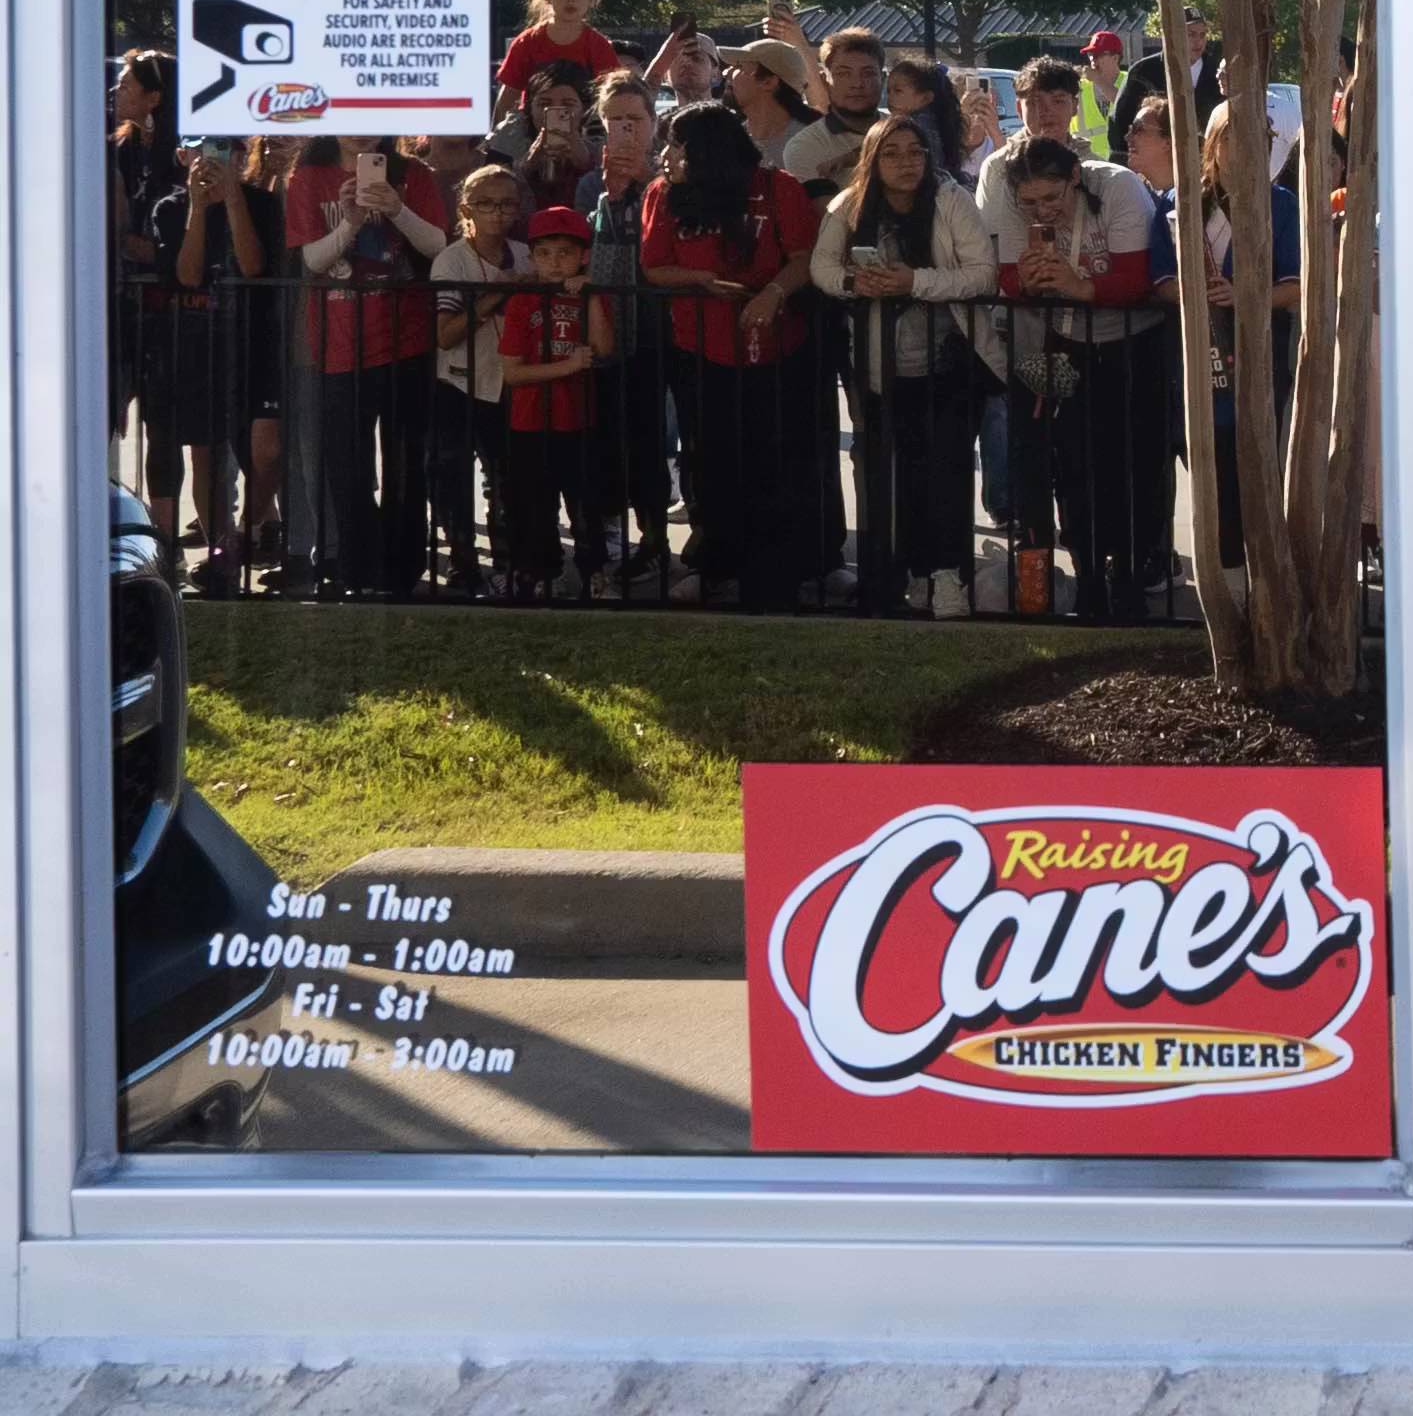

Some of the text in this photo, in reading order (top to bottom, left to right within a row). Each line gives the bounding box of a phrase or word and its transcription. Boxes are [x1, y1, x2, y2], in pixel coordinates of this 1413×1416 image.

[323, 33, 472, 48] AUDIO ARE RECORDED
[326, 14, 469, 30] SECURITY, VIDEO AND
[341, 53, 456, 67] FOR ALL ACTIVITY
[356, 73, 439, 87] ON PREMISE
[250, 83, 328, 121] Cane's
[1002, 830, 1189, 884] Raising
[267, 883, 325, 918] Sun
[367, 884, 451, 922] Thurs
[208, 934, 350, 968] 10:00am
[395, 938, 514, 973] 1:00am
[809, 814, 1361, 1072] Cane's
[292, 984, 339, 1018] Fri
[375, 985, 429, 1020] Sat
[207, 1033, 350, 1068] 10:00am
[390, 1038, 514, 1072] 3:00am
[994, 1036, 1303, 1069] CHICKEN FINGERS
